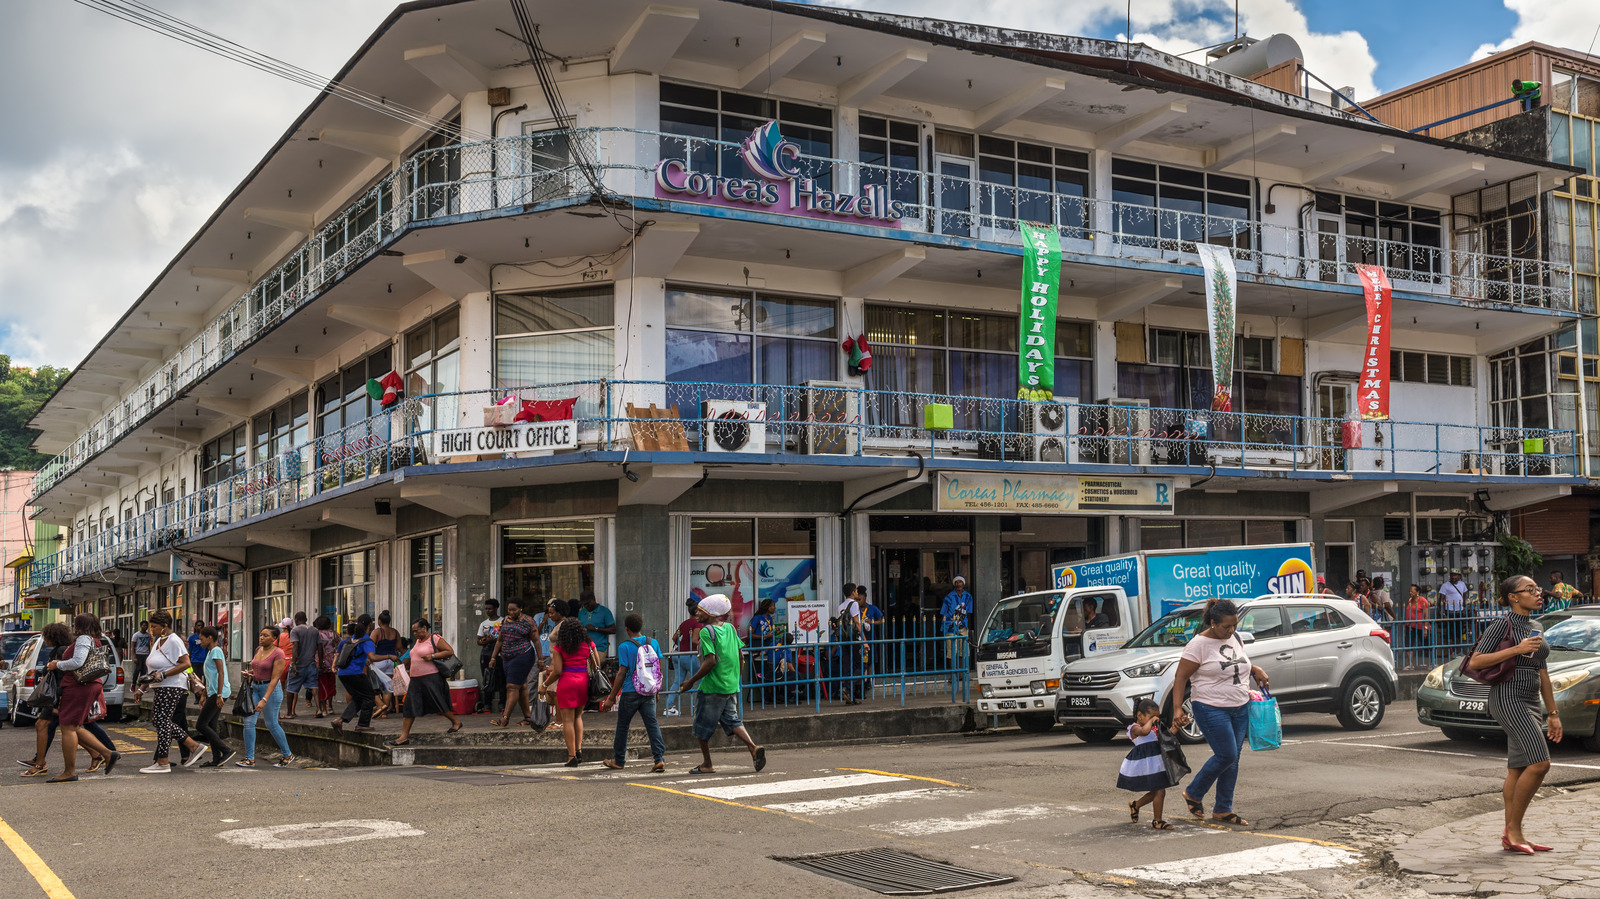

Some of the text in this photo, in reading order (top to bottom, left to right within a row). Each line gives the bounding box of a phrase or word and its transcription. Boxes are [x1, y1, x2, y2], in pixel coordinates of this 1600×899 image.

[657, 158, 904, 221] Coreas Hazells
[1025, 231, 1050, 386] HAPPY HOLIDAYS
[1363, 271, 1382, 410] MERRY CHRISTMAS
[441, 425, 570, 452] HIGH COURT OFFICE
[1084, 480, 1122, 488] PHARMACEUTICAL
[947, 478, 1075, 509] Coreas Pharmacy
[176, 568, 196, 576] Food
[1080, 559, 1136, 576] Great quality,
[1172, 560, 1261, 580] Great quality,
[1057, 573, 1073, 589] SUN
[1087, 572, 1130, 587] best price!
[1267, 570, 1306, 598] SUN
[1184, 578, 1252, 599] best price!
[996, 651, 1017, 660] NISSAN
[986, 661, 1009, 671] GENERAL &
[986, 669, 1006, 677] MARITIME
[1006, 667, 1028, 676] AGENCIES
[1071, 697, 1090, 706] P8524
[1459, 700, 1485, 711] P298
